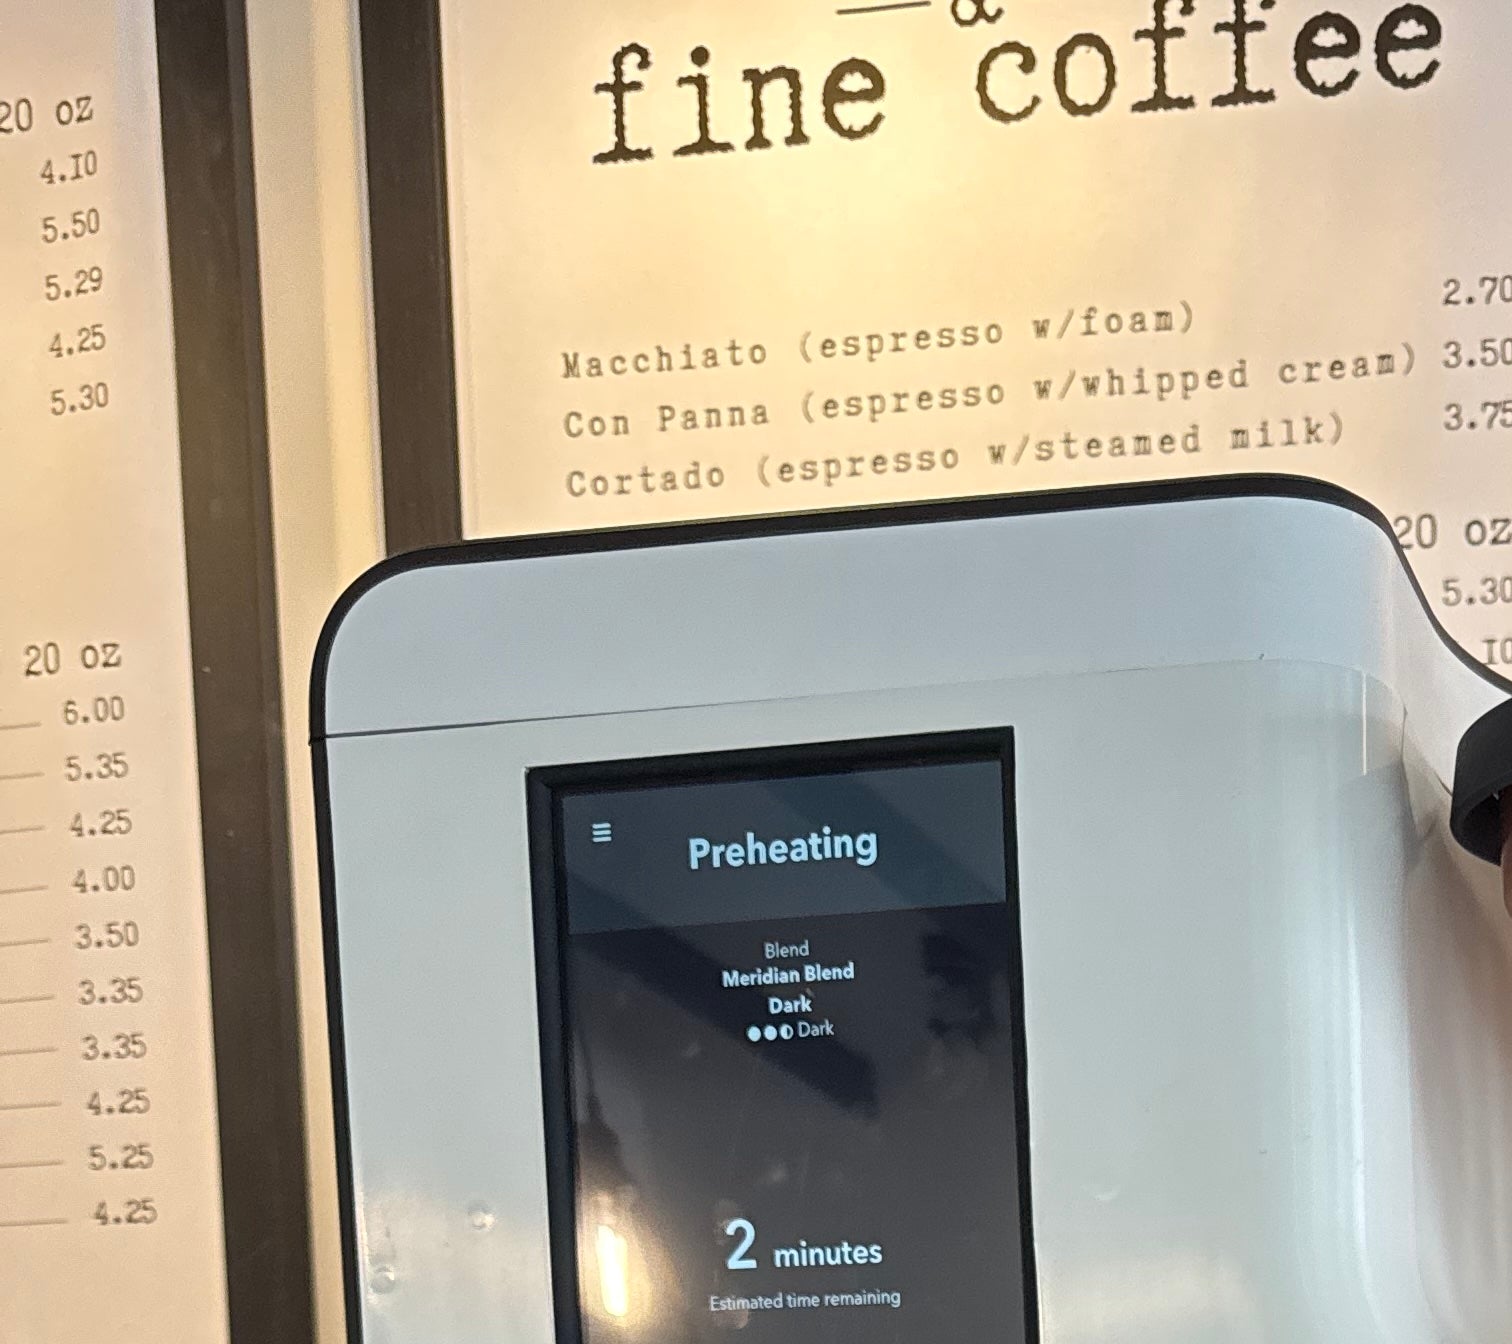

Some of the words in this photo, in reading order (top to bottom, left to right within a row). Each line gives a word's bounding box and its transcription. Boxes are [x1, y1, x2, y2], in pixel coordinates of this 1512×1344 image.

[592, 42, 887, 164] fine
[976, 0, 1443, 124] coffee
[0, 97, 33, 133] 20
[56, 96, 94, 126] oz
[42, 207, 100, 243] 5.50
[45, 266, 103, 301] 5.29
[49, 323, 106, 358] 4.25
[562, 341, 768, 380] Macchiato
[799, 320, 1004, 363] (espresso
[1032, 300, 1195, 341] w/foam)
[51, 382, 110, 416] 5.30
[563, 411, 630, 439] Con
[656, 402, 771, 435] Panna
[801, 380, 1006, 423] (espresso
[1033, 357, 1250, 402] w/whipped
[1278, 342, 1418, 384] cream)
[565, 459, 726, 498] Cortado
[757, 444, 960, 488] (espresso
[987, 424, 1202, 466] w/steamed
[1229, 412, 1345, 450] milk)
[1393, 512, 1438, 551] 20
[24, 641, 61, 677] 20
[81, 643, 122, 670] oz
[64, 695, 125, 726] 6.00
[65, 751, 129, 782] 5.35
[71, 808, 132, 838] 4.25
[688, 825, 879, 870] Preheating
[73, 864, 136, 893] 4.00
[74, 920, 140, 950] 3.50
[764, 940, 810, 960] Blend
[721, 967, 800, 989] Meridian
[804, 961, 855, 983] Blend
[78, 976, 143, 1006] 3.35
[768, 996, 812, 1016] Dark
[797, 1021, 835, 1038] Dark
[81, 1032, 147, 1061] 3.35
[87, 1087, 151, 1116] 4.25
[88, 1142, 155, 1171] 5.25
[93, 1197, 158, 1226] 4.25
[724, 1217, 758, 1271] 2
[773, 1238, 883, 1269] minutes
[709, 1292, 784, 1312] Estimated
[786, 1291, 820, 1309] time
[823, 1288, 901, 1309] remaining
